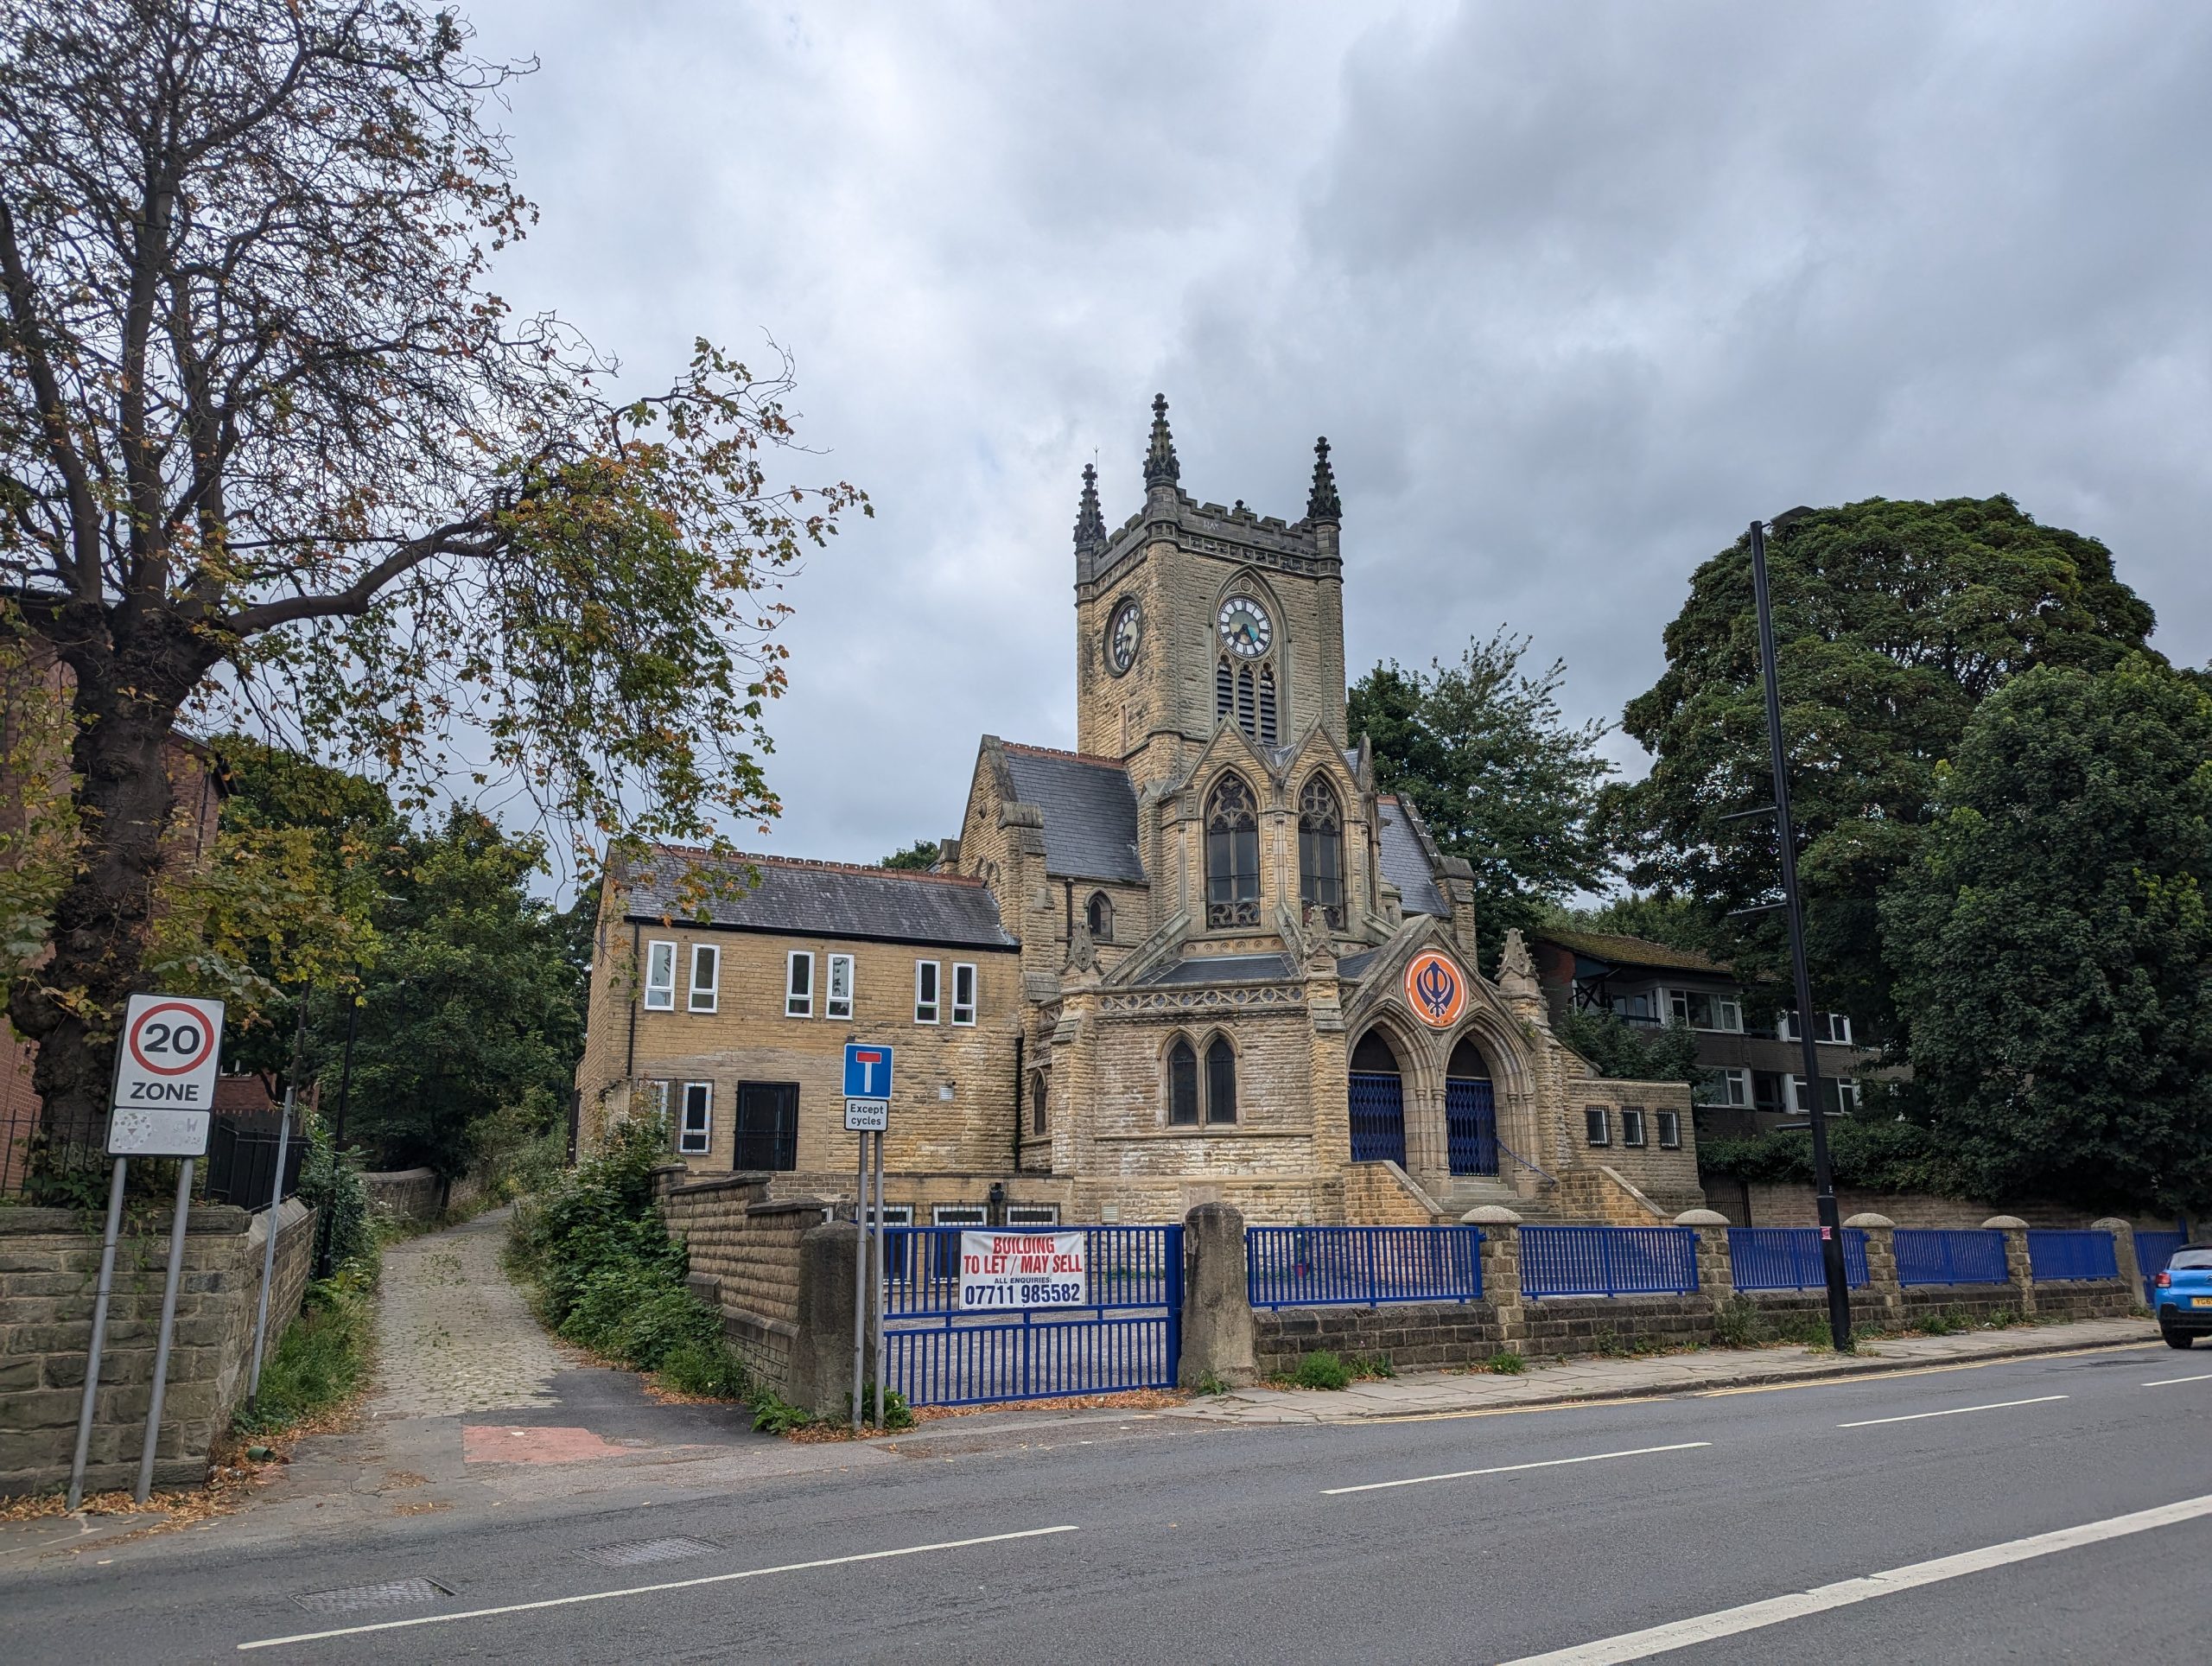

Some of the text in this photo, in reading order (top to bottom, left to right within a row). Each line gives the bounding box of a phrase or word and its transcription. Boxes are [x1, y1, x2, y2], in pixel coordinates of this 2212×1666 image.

[144, 1023, 200, 1054] 20
[130, 1082, 199, 1102] ZONE
[850, 1103, 884, 1115] Except
[851, 1116, 881, 1126] cycles
[993, 1237, 1055, 1254] BUILDING
[963, 1256, 980, 1275] TO
[984, 1256, 1007, 1274] LET
[1020, 1255, 1049, 1274] MAY
[1052, 1254, 1083, 1274] SELL
[965, 1283, 1080, 1305] 07711 985582
